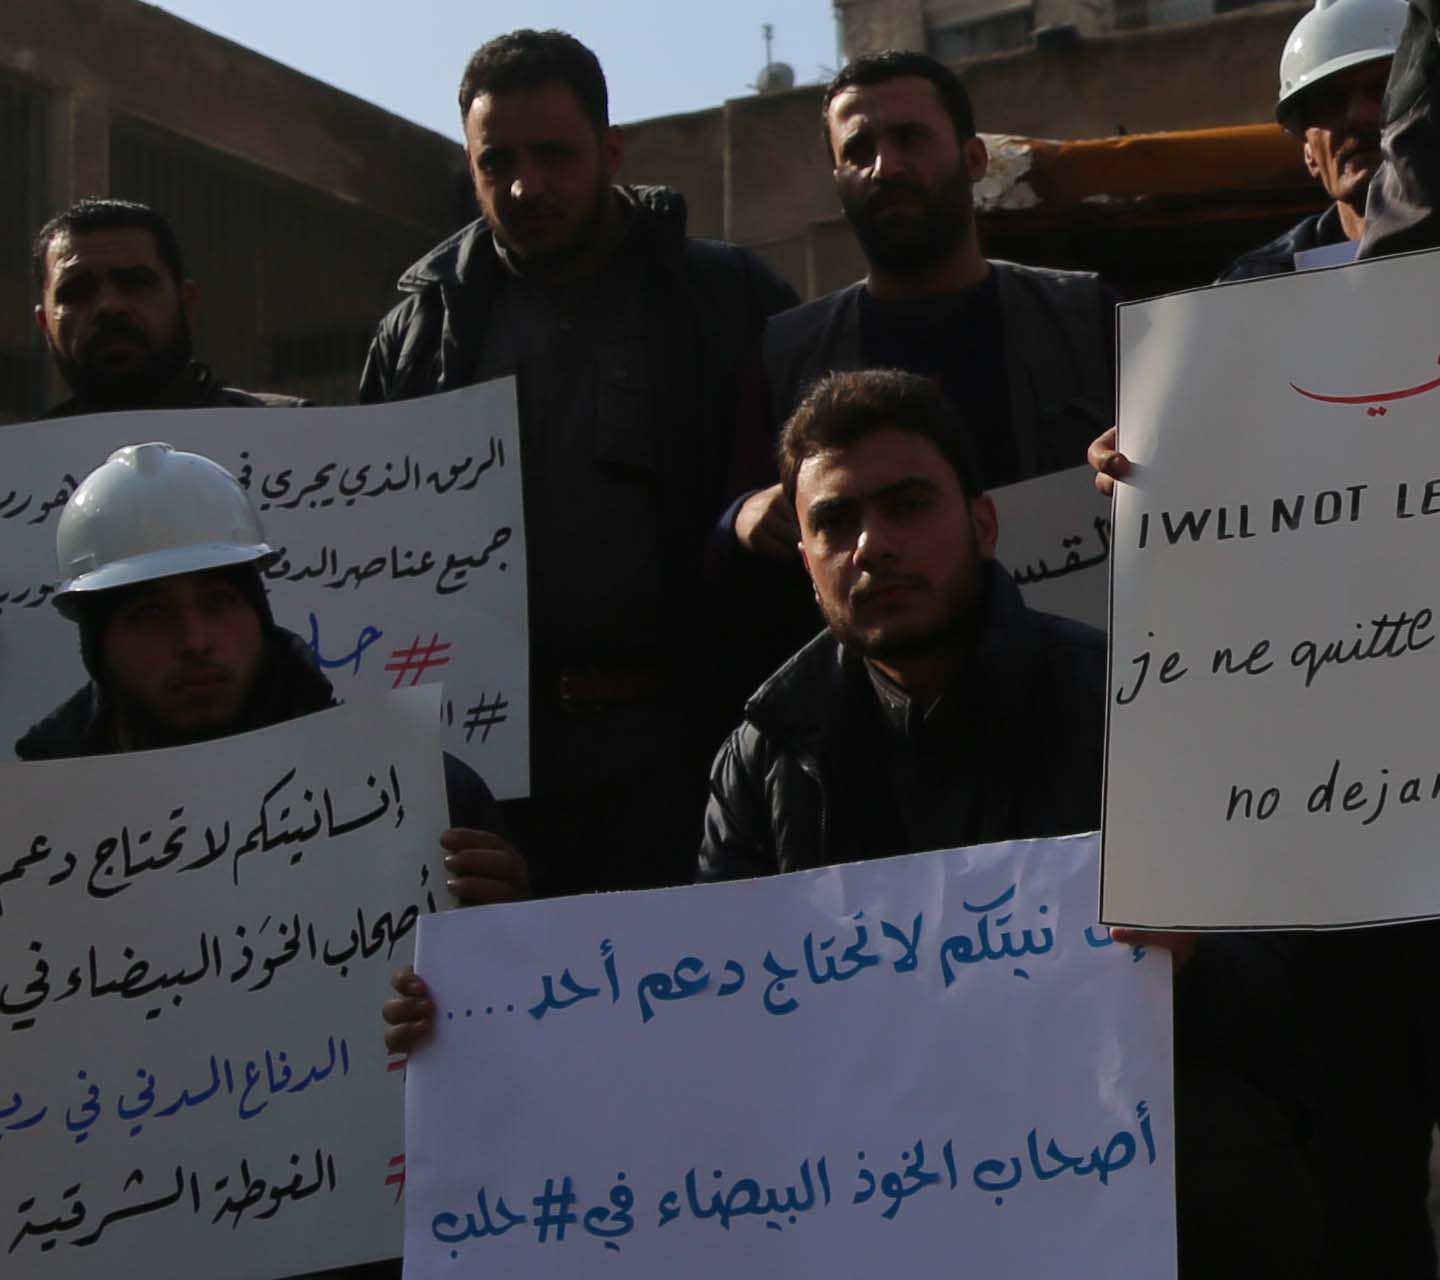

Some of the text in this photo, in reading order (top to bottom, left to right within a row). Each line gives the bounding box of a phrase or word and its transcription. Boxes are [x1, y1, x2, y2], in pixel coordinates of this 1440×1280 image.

[260, 463, 338, 511] يجري
[339, 456, 421, 507] الذي
[1138, 513, 1150, 549] I
[1161, 505, 1256, 545] WLL
[1271, 485, 1368, 533] NOT
[436, 527, 513, 595] جميع
[1116, 632, 1188, 705] je
[1212, 639, 1274, 675] ne
[1291, 608, 1435, 688] quitte
[233, 764, 405, 886] إنسانيتكم
[1226, 783, 1280, 821] no
[87, 806, 187, 899] تحتاج
[175, 820, 230, 874] لا
[53, 932, 223, 1021] البيضاء
[527, 938, 621, 1020] أحد
[763, 910, 881, 1016] تحتاج
[881, 911, 923, 973] لا
[637, 956, 746, 1025] دعم
[65, 1069, 101, 1145] في
[117, 1055, 234, 1137] المدني
[239, 1035, 350, 1120] الدفاع
[211, 1147, 336, 1230] الغوطة
[658, 1155, 832, 1232] البيضاء
[852, 1138, 958, 1220] الخوذ
[972, 1099, 1157, 1207] أصحاب
[8, 1164, 201, 1254] الشرقية
[583, 1171, 635, 1253] في
